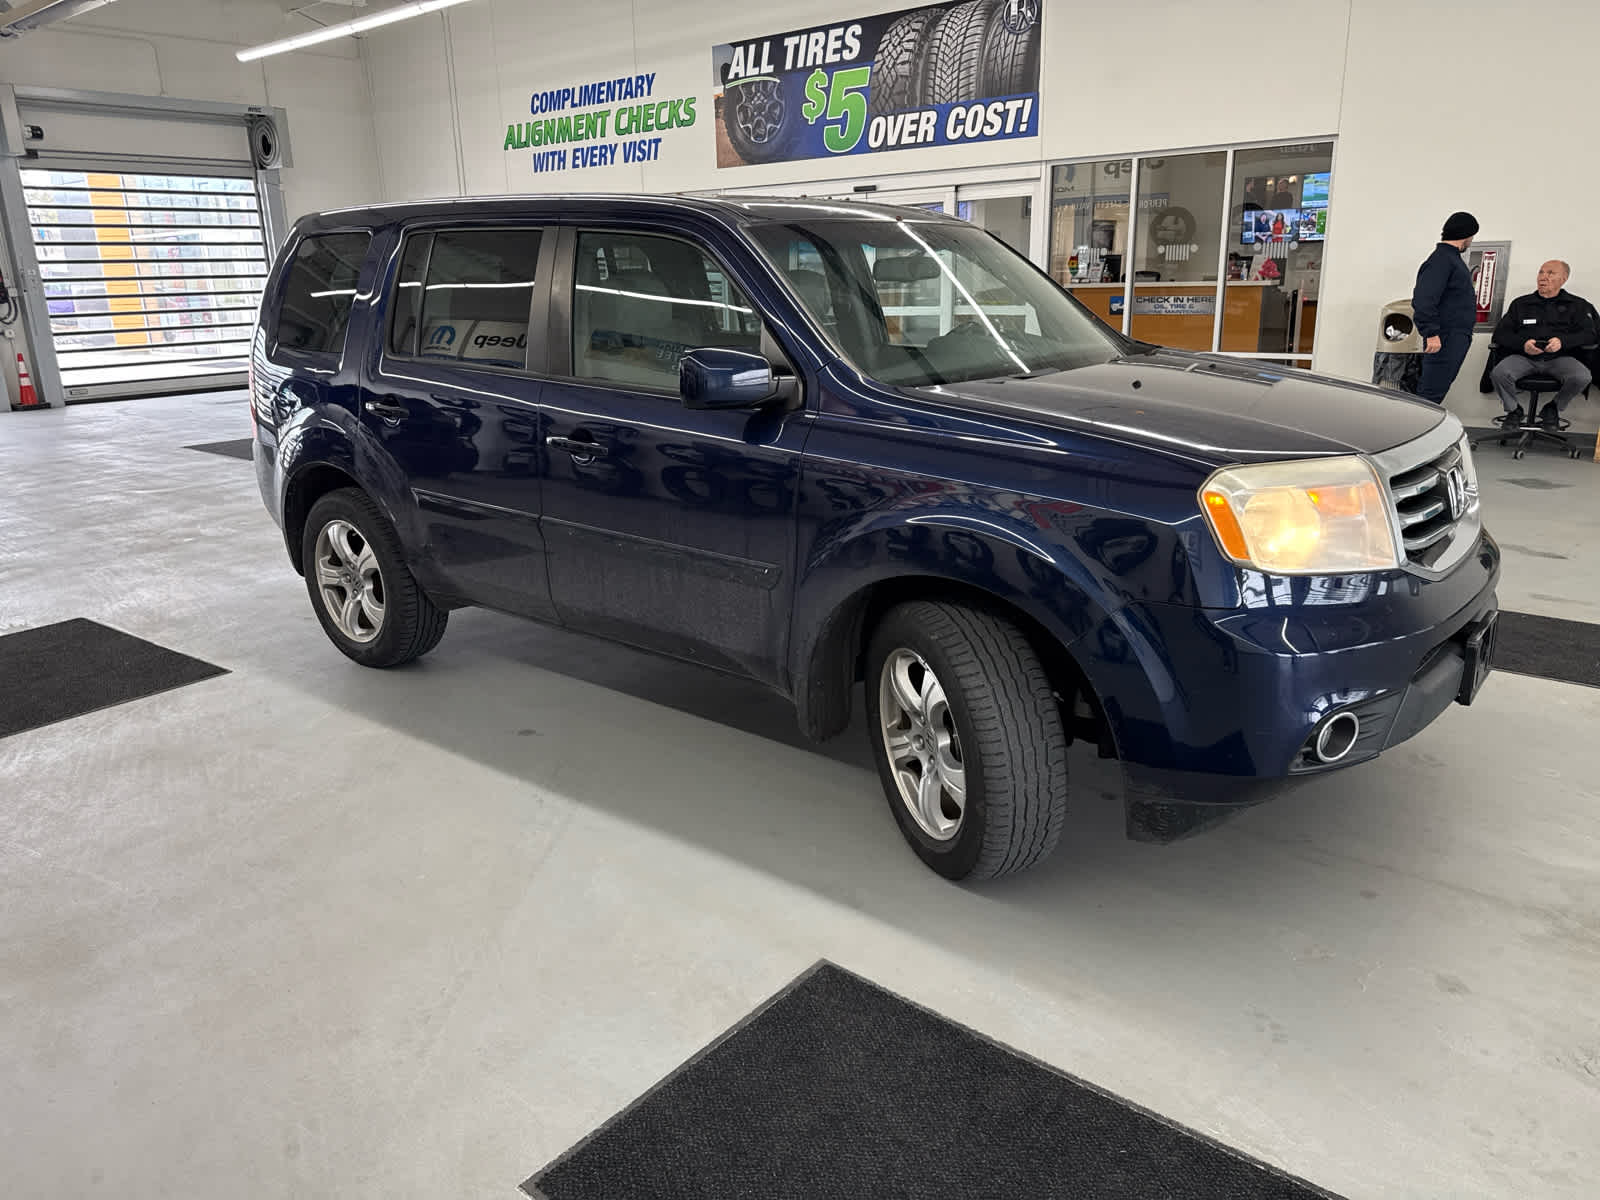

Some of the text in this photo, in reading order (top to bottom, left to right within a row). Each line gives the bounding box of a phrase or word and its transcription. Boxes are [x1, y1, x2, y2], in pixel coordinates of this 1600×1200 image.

[728, 24, 862, 80] ALL TIRES
[531, 73, 656, 115] COMPLIMENTARY
[802, 67, 871, 153] $5
[504, 96, 697, 151] ALIGNMENT CHECKS
[868, 98, 1033, 149] OVER COST!
[533, 138, 662, 173] WITH EVERY VISIT
